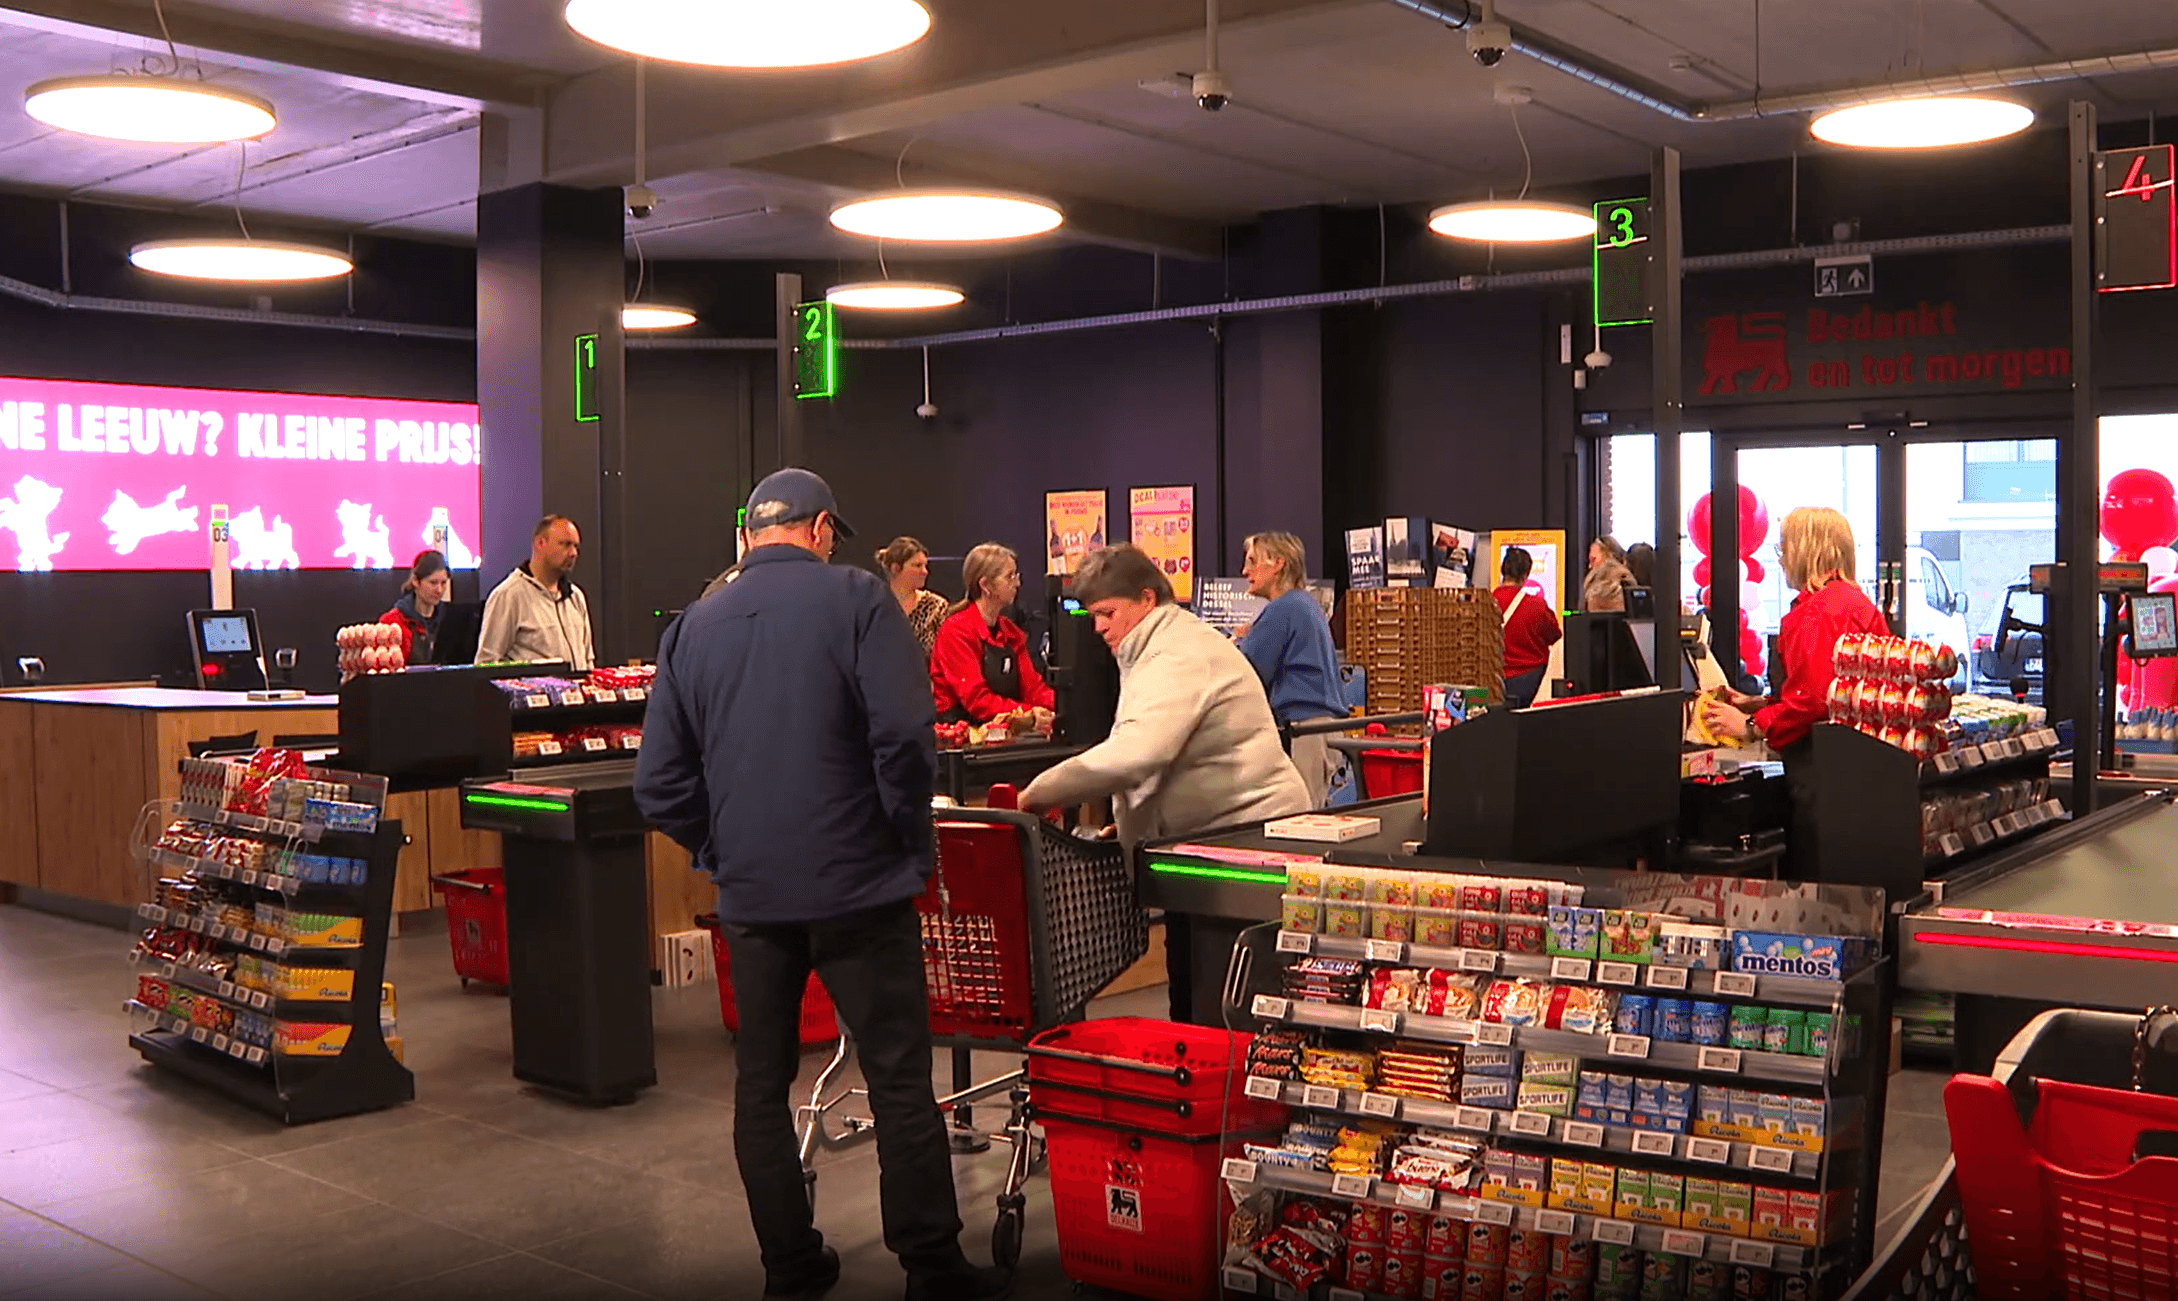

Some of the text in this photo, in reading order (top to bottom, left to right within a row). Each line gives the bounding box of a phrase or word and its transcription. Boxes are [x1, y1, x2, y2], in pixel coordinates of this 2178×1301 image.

[2121, 155, 2155, 201] 4
[1610, 208, 1635, 247] 3
[805, 307, 822, 340] 2
[1807, 302, 1957, 343] Bedankt
[584, 339, 594, 369] 1
[1808, 347, 2071, 388] en tot morgen
[57, 403, 224, 456] LEEUW?
[237, 411, 366, 460] KLEINE
[375, 419, 481, 465] PRIJS!
[213, 527, 228, 542] 03
[1742, 956, 1832, 976] mentos
[1465, 1054, 1507, 1066] SPORTLIFE
[1524, 1062, 1569, 1074] SPORTLIFE
[1463, 1085, 1505, 1097] SPORTLIFE
[1519, 1093, 1565, 1106] SPORTLIFE
[1709, 1126, 1742, 1138] Ricola
[1772, 1134, 1805, 1147] Ricola
